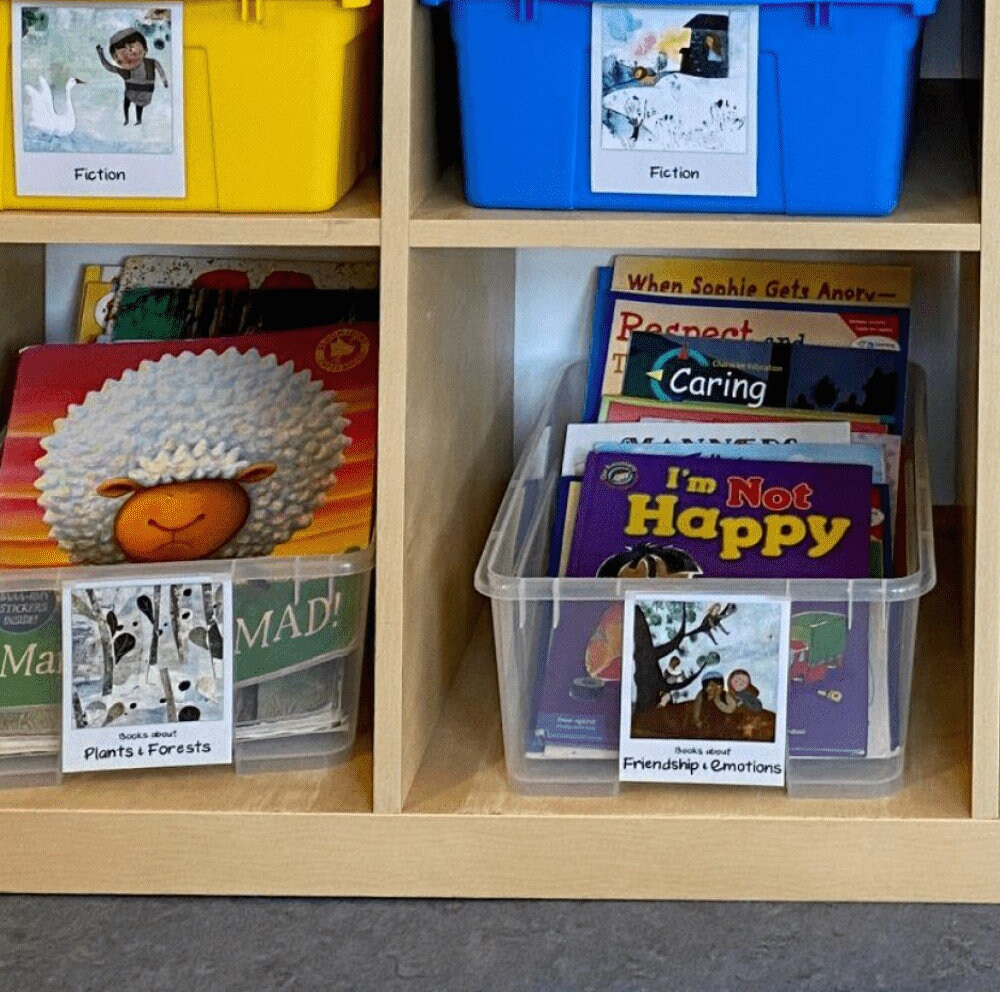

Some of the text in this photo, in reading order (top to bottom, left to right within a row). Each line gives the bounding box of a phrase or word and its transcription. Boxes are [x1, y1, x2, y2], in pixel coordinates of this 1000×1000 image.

[74, 167, 126, 181] Fiction
[649, 165, 700, 179] Fiction
[627, 273, 683, 294] When
[690, 275, 757, 298] Sophie
[765, 279, 810, 299] Gets
[669, 367, 768, 408] Caring
[665, 465, 814, 511] I'm Not
[623, 493, 852, 560] Happy
[234, 592, 342, 655] MAD!
[119, 730, 177, 740] Books about
[84, 739, 212, 760] Plants Forests
[674, 747, 704, 755] Books
[623, 756, 699, 776] Friendship
